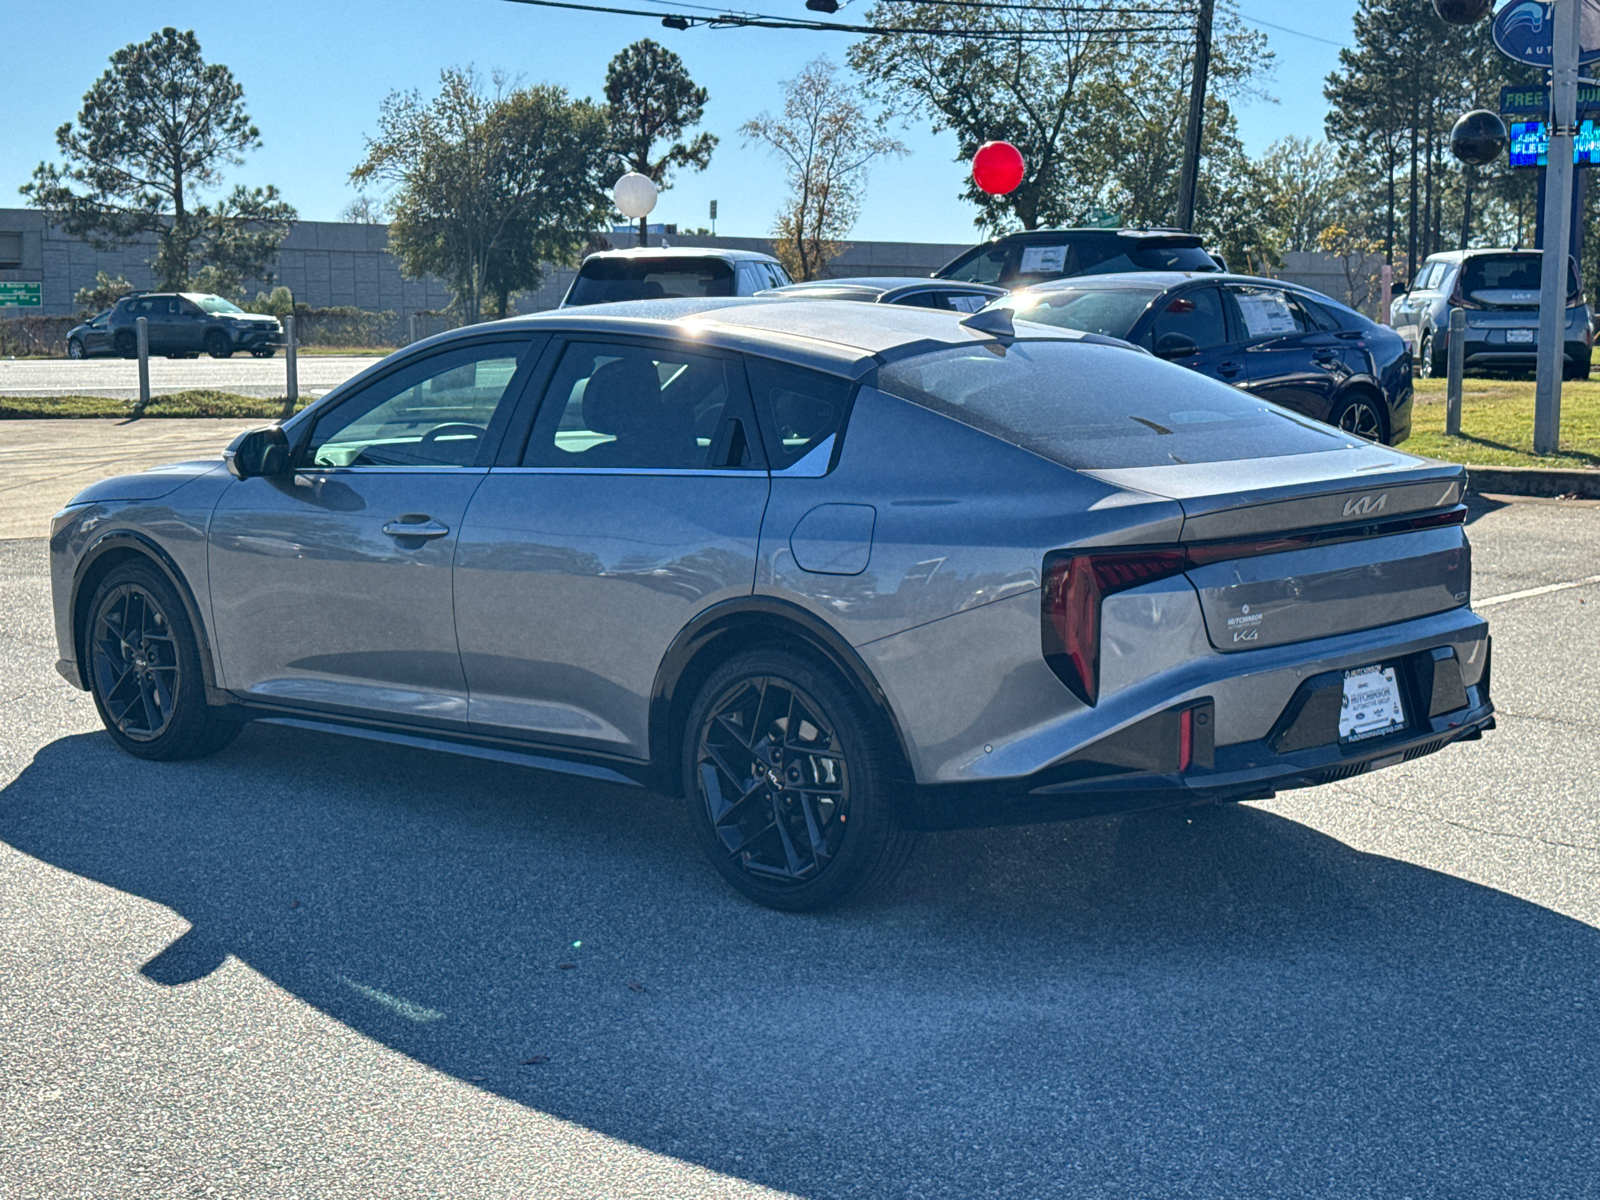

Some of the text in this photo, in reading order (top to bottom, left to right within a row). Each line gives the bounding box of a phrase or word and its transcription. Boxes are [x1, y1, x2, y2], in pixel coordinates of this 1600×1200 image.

[1525, 45, 1553, 55] AUT
[1505, 91, 1543, 107] FREE
[1515, 142, 1549, 155] FLEE
[1342, 493, 1388, 517] KIA
[1227, 613, 1263, 626] HUTCHINSON
[1233, 629, 1258, 642] K4
[1350, 687, 1391, 705] HUTCHINSON
